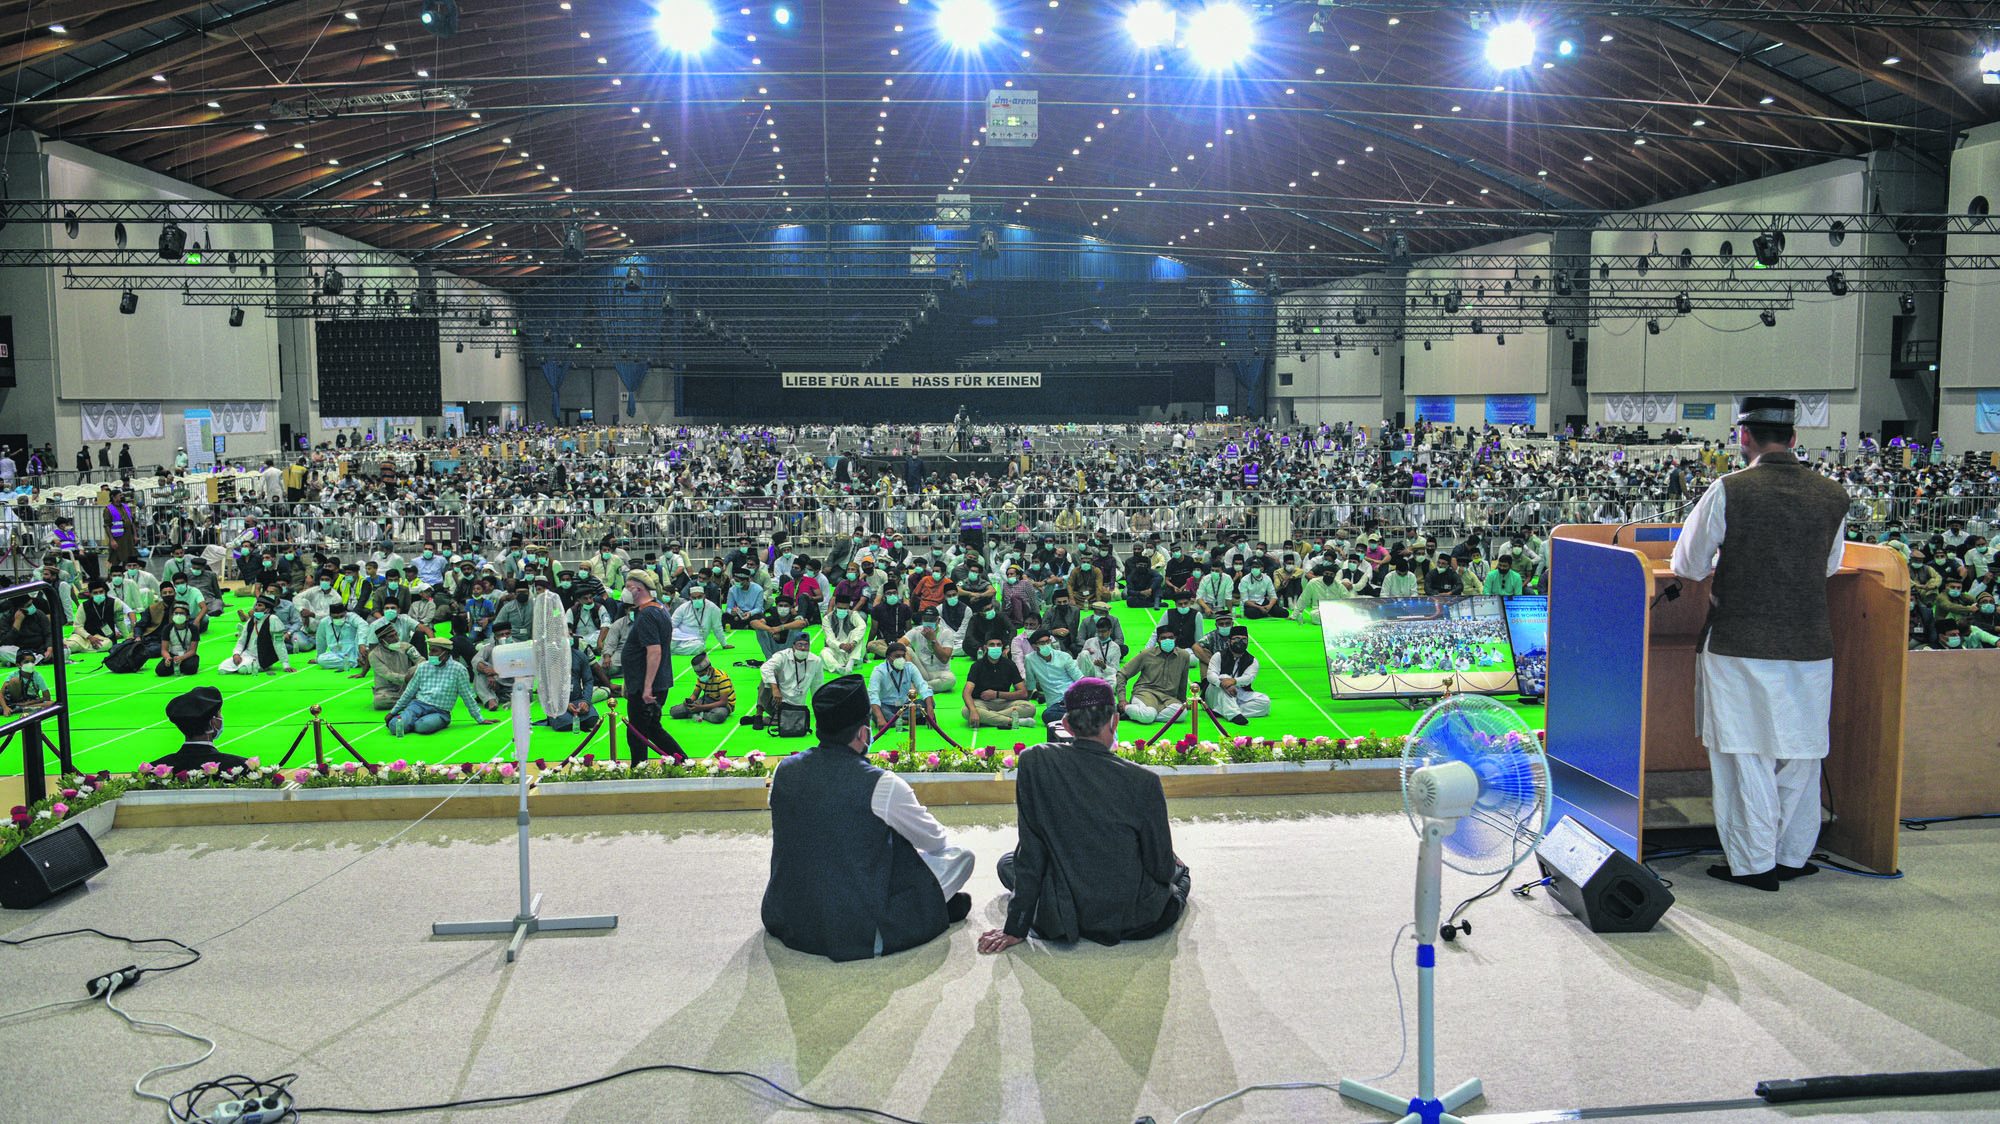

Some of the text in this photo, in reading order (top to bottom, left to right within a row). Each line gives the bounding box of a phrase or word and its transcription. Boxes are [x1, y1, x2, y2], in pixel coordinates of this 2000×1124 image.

[995, 96, 1037, 105] dm-arena
[786, 374, 1039, 386] LIEBE FÜR ALLE HASS FÜR KEINEN
